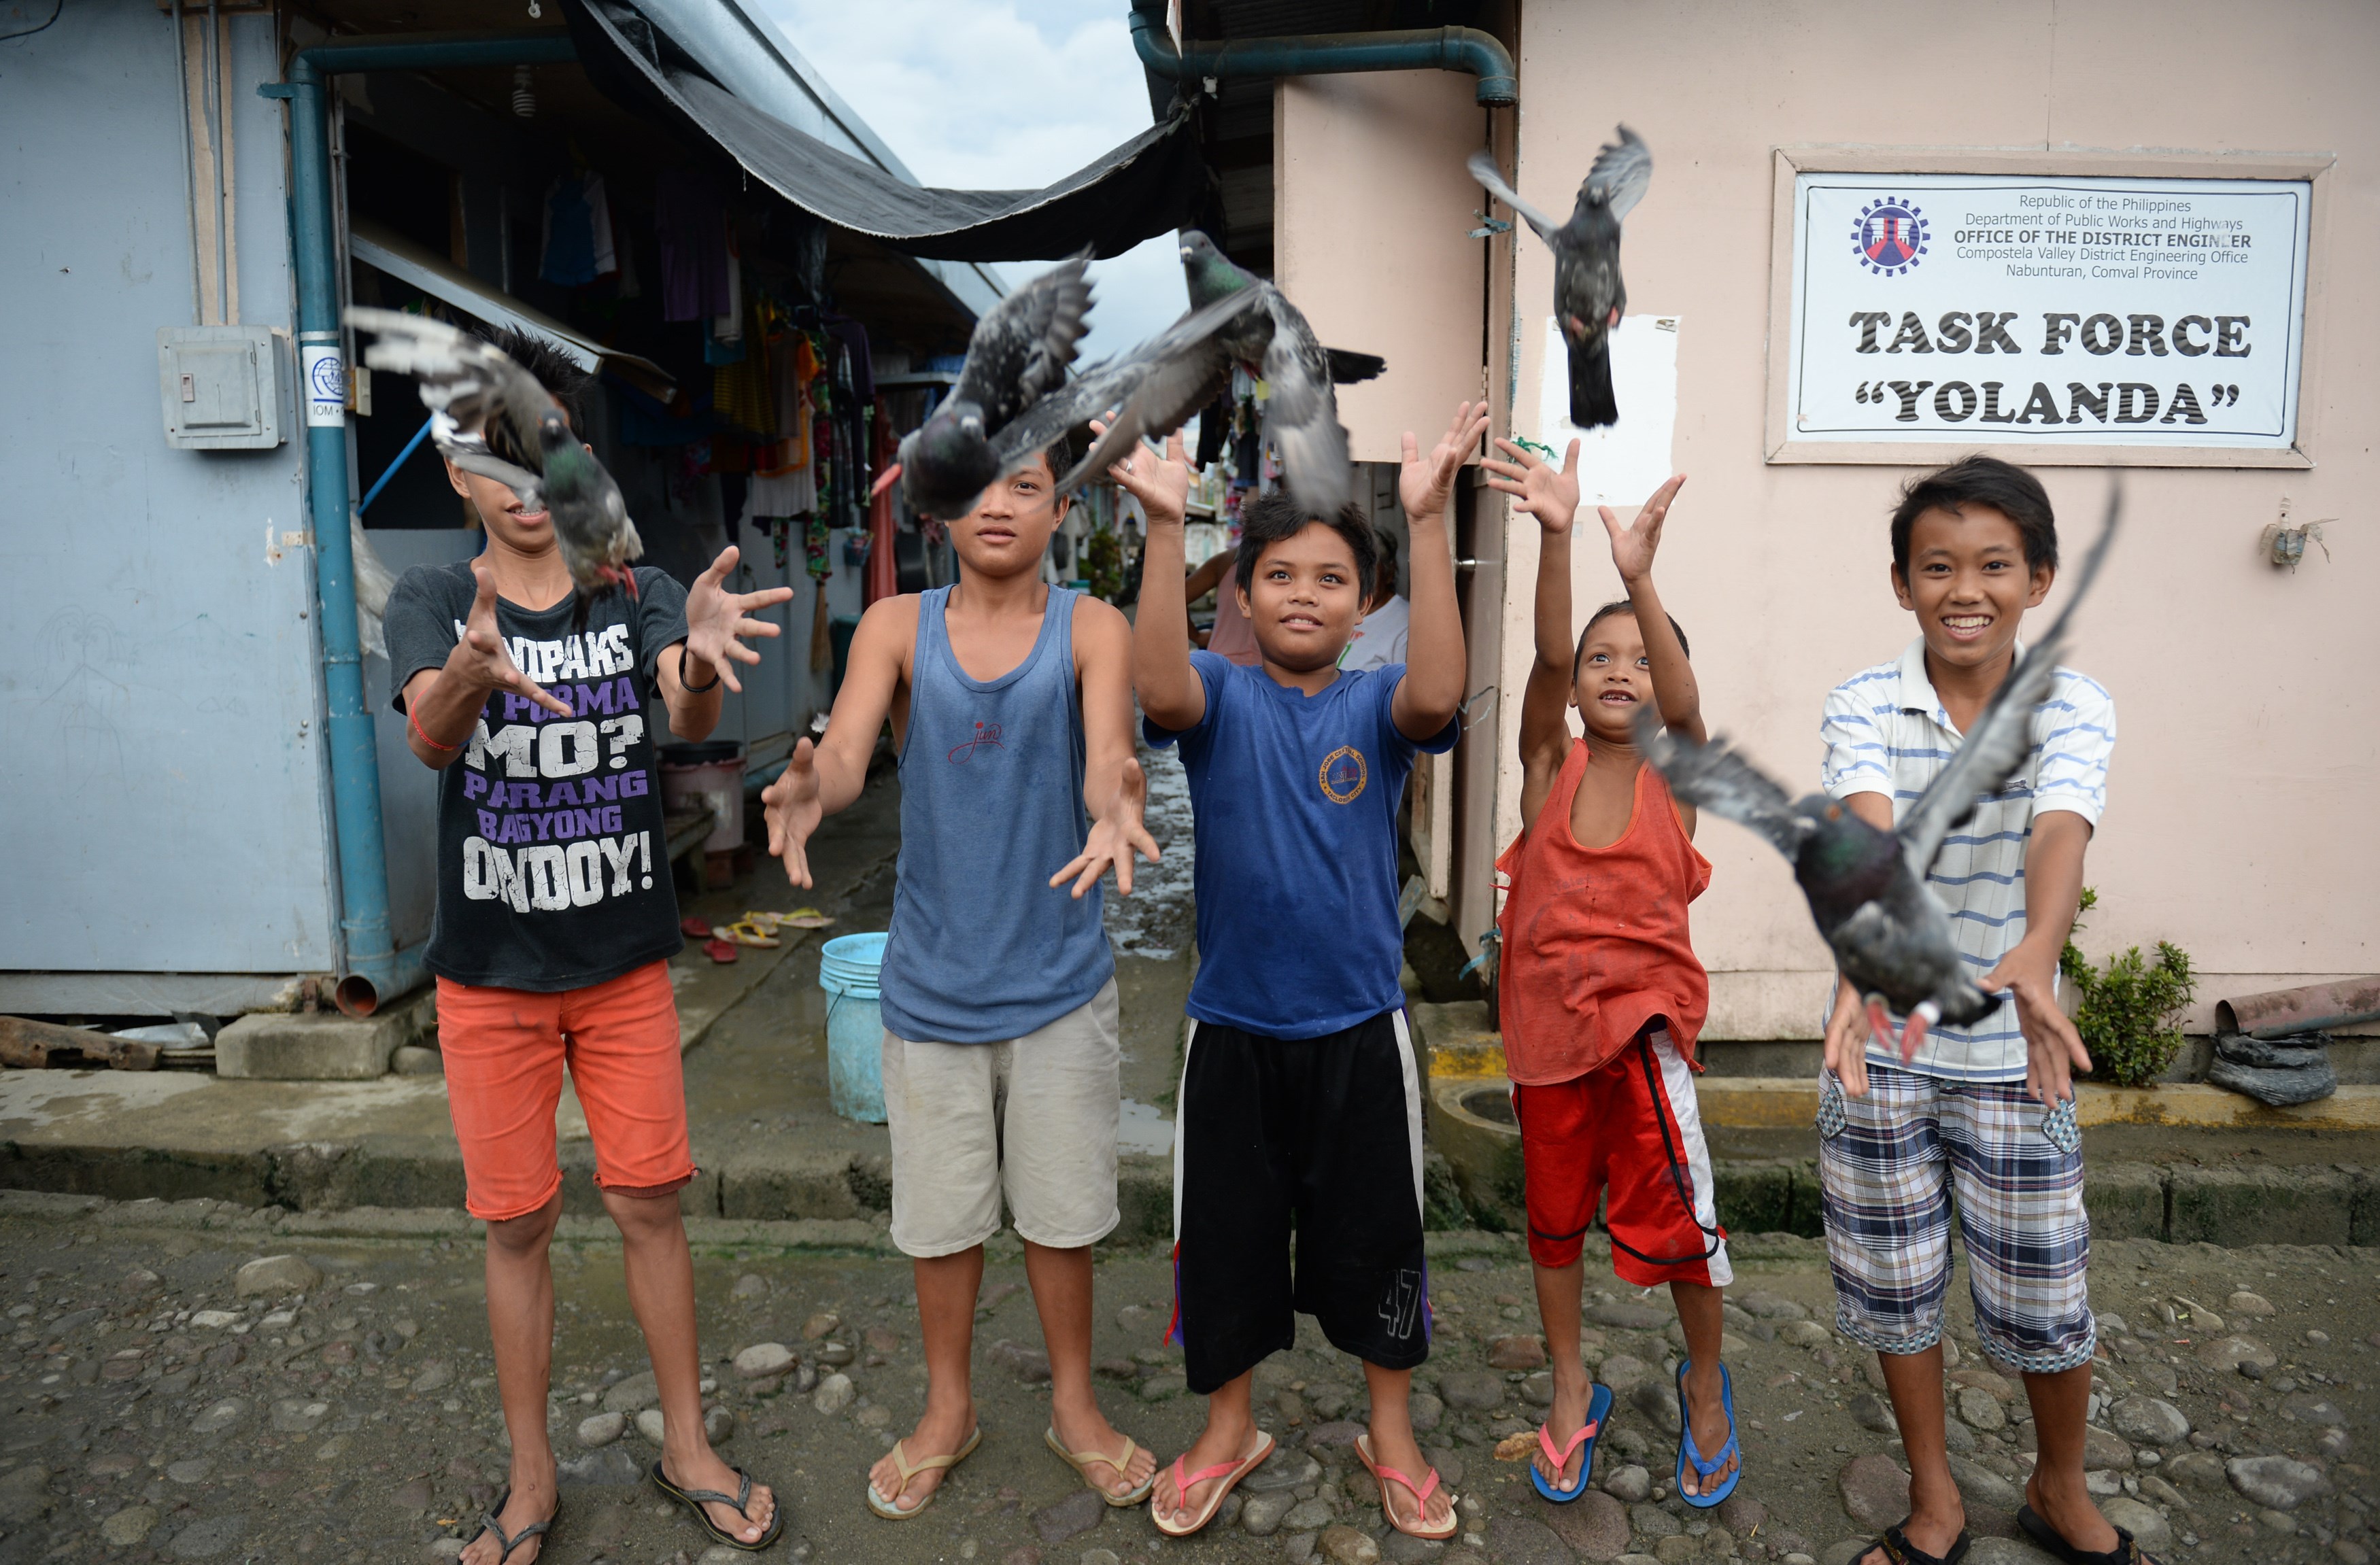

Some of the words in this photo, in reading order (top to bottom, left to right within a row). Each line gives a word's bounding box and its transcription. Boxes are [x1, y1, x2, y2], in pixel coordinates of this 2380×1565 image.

[2020, 195, 2075, 209] Republic
[2079, 196, 2092, 209] of
[2096, 197, 2118, 210] the
[2123, 199, 2191, 213] Philippines
[1966, 213, 2043, 228] Department
[2048, 213, 2061, 226] of
[2066, 213, 2103, 227] Public
[2108, 216, 2147, 228] Works
[2152, 217, 2176, 229] and
[2181, 217, 2243, 232] Highways
[1954, 230, 2013, 243] OFFICE
[2019, 230, 2041, 243] OF
[2045, 230, 2077, 244] THE
[2082, 232, 2162, 246] DISTRICT
[1957, 246, 2033, 261] Compostela
[2038, 247, 2075, 262] Valley
[2080, 247, 2126, 260] District
[2130, 250, 2206, 265] Engineering
[2211, 250, 2248, 263] Office
[2007, 264, 2086, 279] Nabunturan,
[2092, 265, 2139, 279] Comval
[2143, 266, 2198, 279] Province
[1849, 311, 2022, 355] TASK
[2040, 312, 2251, 358] FORCE
[313, 405, 333, 416] IOM
[1855, 379, 2240, 425] “YOLANDA”
[464, 714, 645, 778] MO?
[1355, 755, 1366, 778] SCHOOL
[464, 770, 648, 809] PARANG
[1350, 786, 1361, 797] CITY
[477, 805, 622, 844] BAGYONG
[463, 831, 653, 913] ONDOY!
